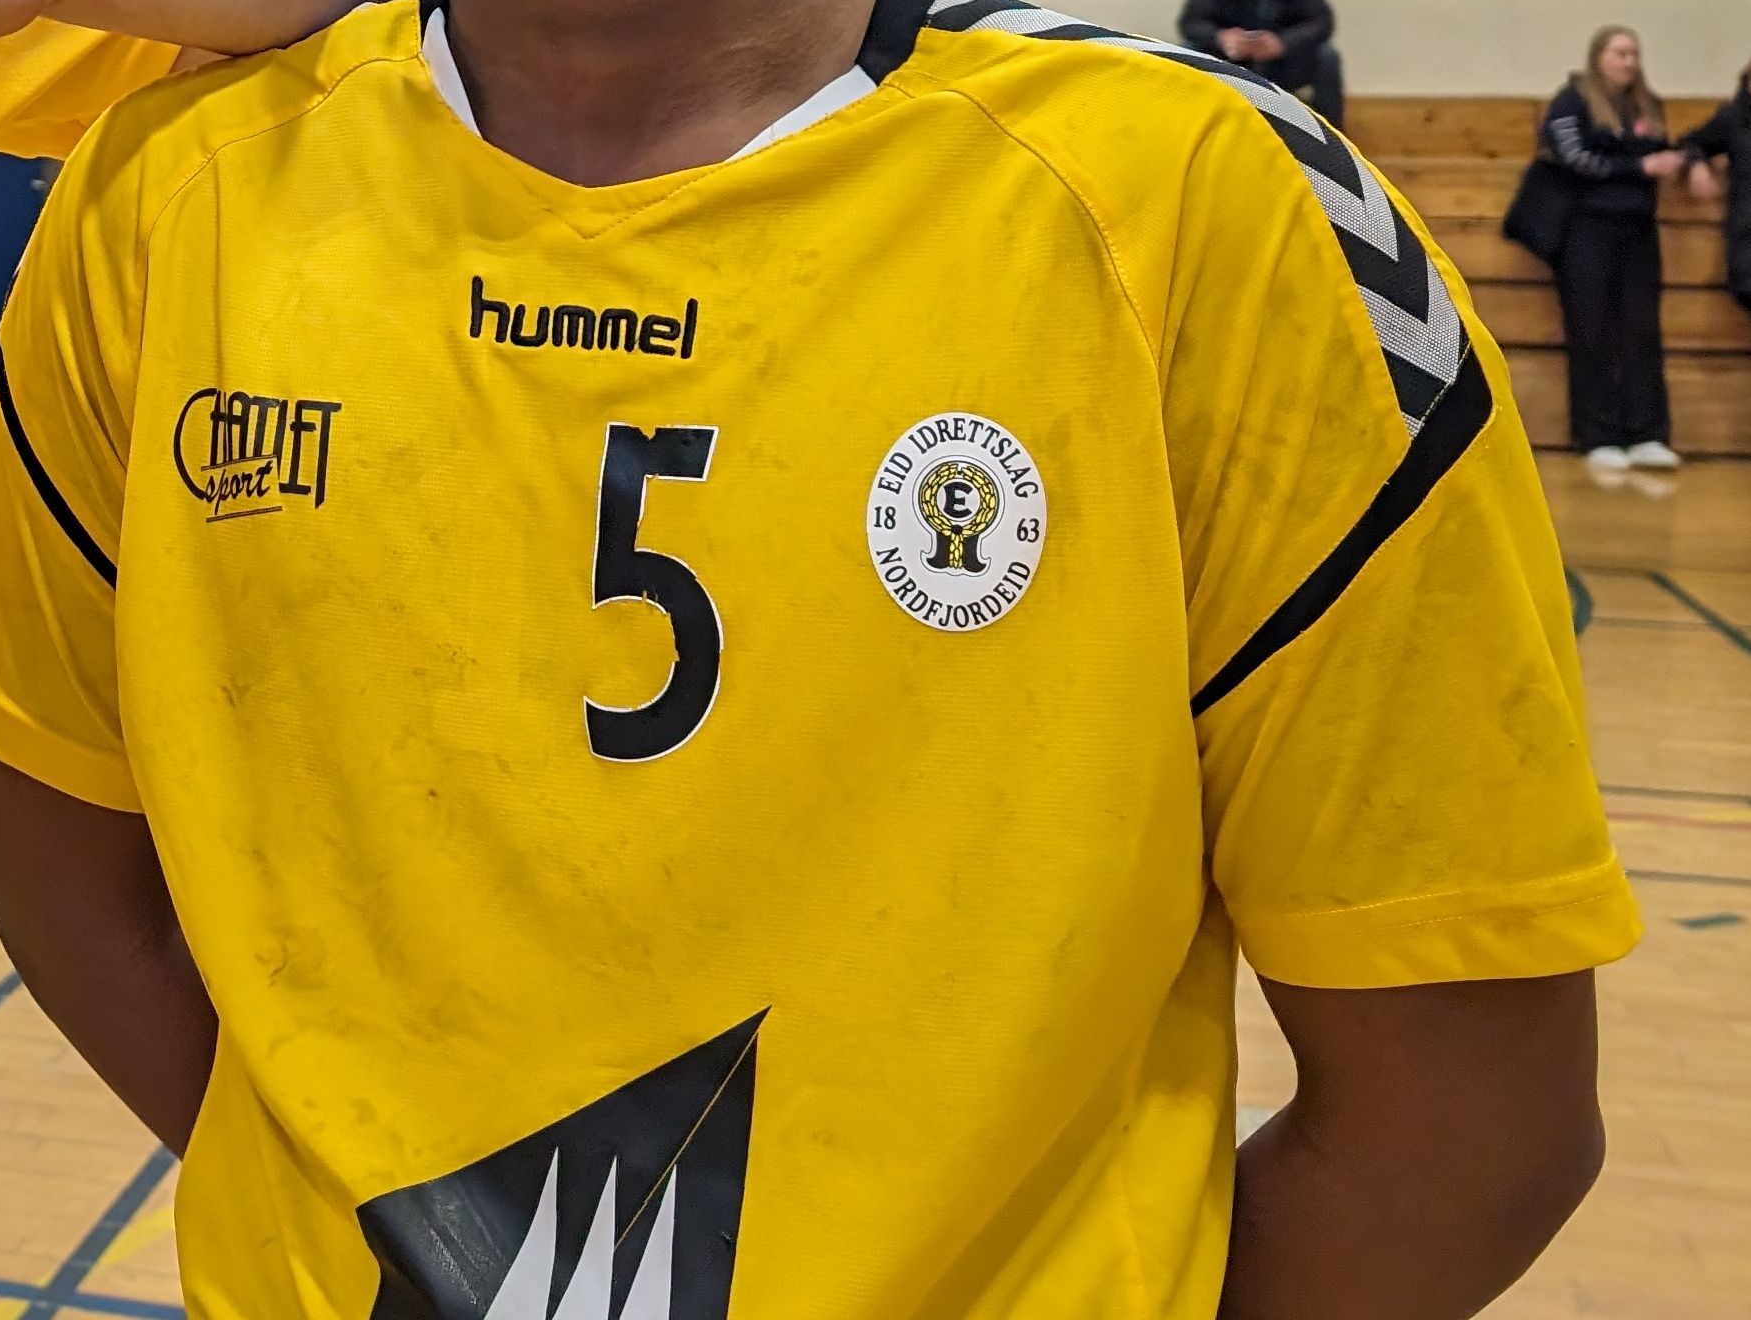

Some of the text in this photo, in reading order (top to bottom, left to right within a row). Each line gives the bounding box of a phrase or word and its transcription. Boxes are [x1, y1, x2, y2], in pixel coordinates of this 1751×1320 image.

[470, 275, 699, 359] hummel
[206, 460, 273, 515] sport
[878, 418, 1039, 498] EID IDRETTSLAG
[873, 506, 896, 530] 18
[943, 481, 973, 518] E
[1016, 518, 1040, 543] 63
[583, 421, 725, 762] 5
[876, 547, 1031, 629] NORDFJORDEID
